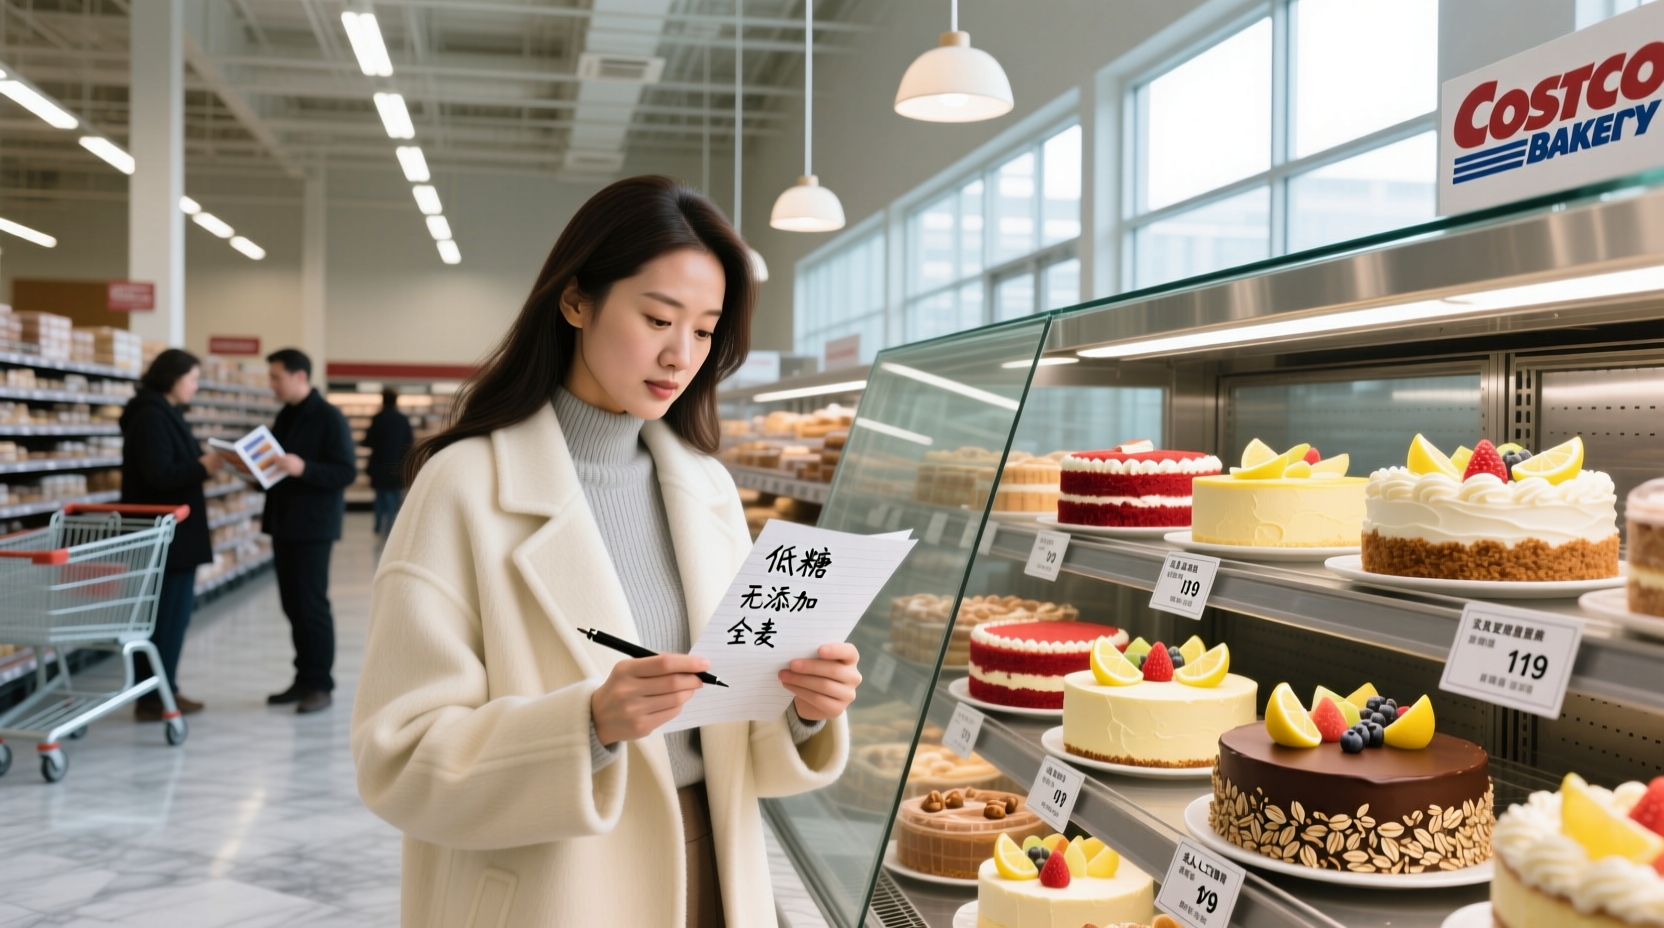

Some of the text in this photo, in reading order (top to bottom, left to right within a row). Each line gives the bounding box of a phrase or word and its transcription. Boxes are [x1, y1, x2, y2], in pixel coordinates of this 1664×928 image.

[1454, 41, 1664, 149] COSTCO
[765, 544, 832, 579] 低糖
[740, 584, 818, 612] 无添加
[727, 616, 777, 649] 全麦
[1507, 649, 1549, 680] 119
